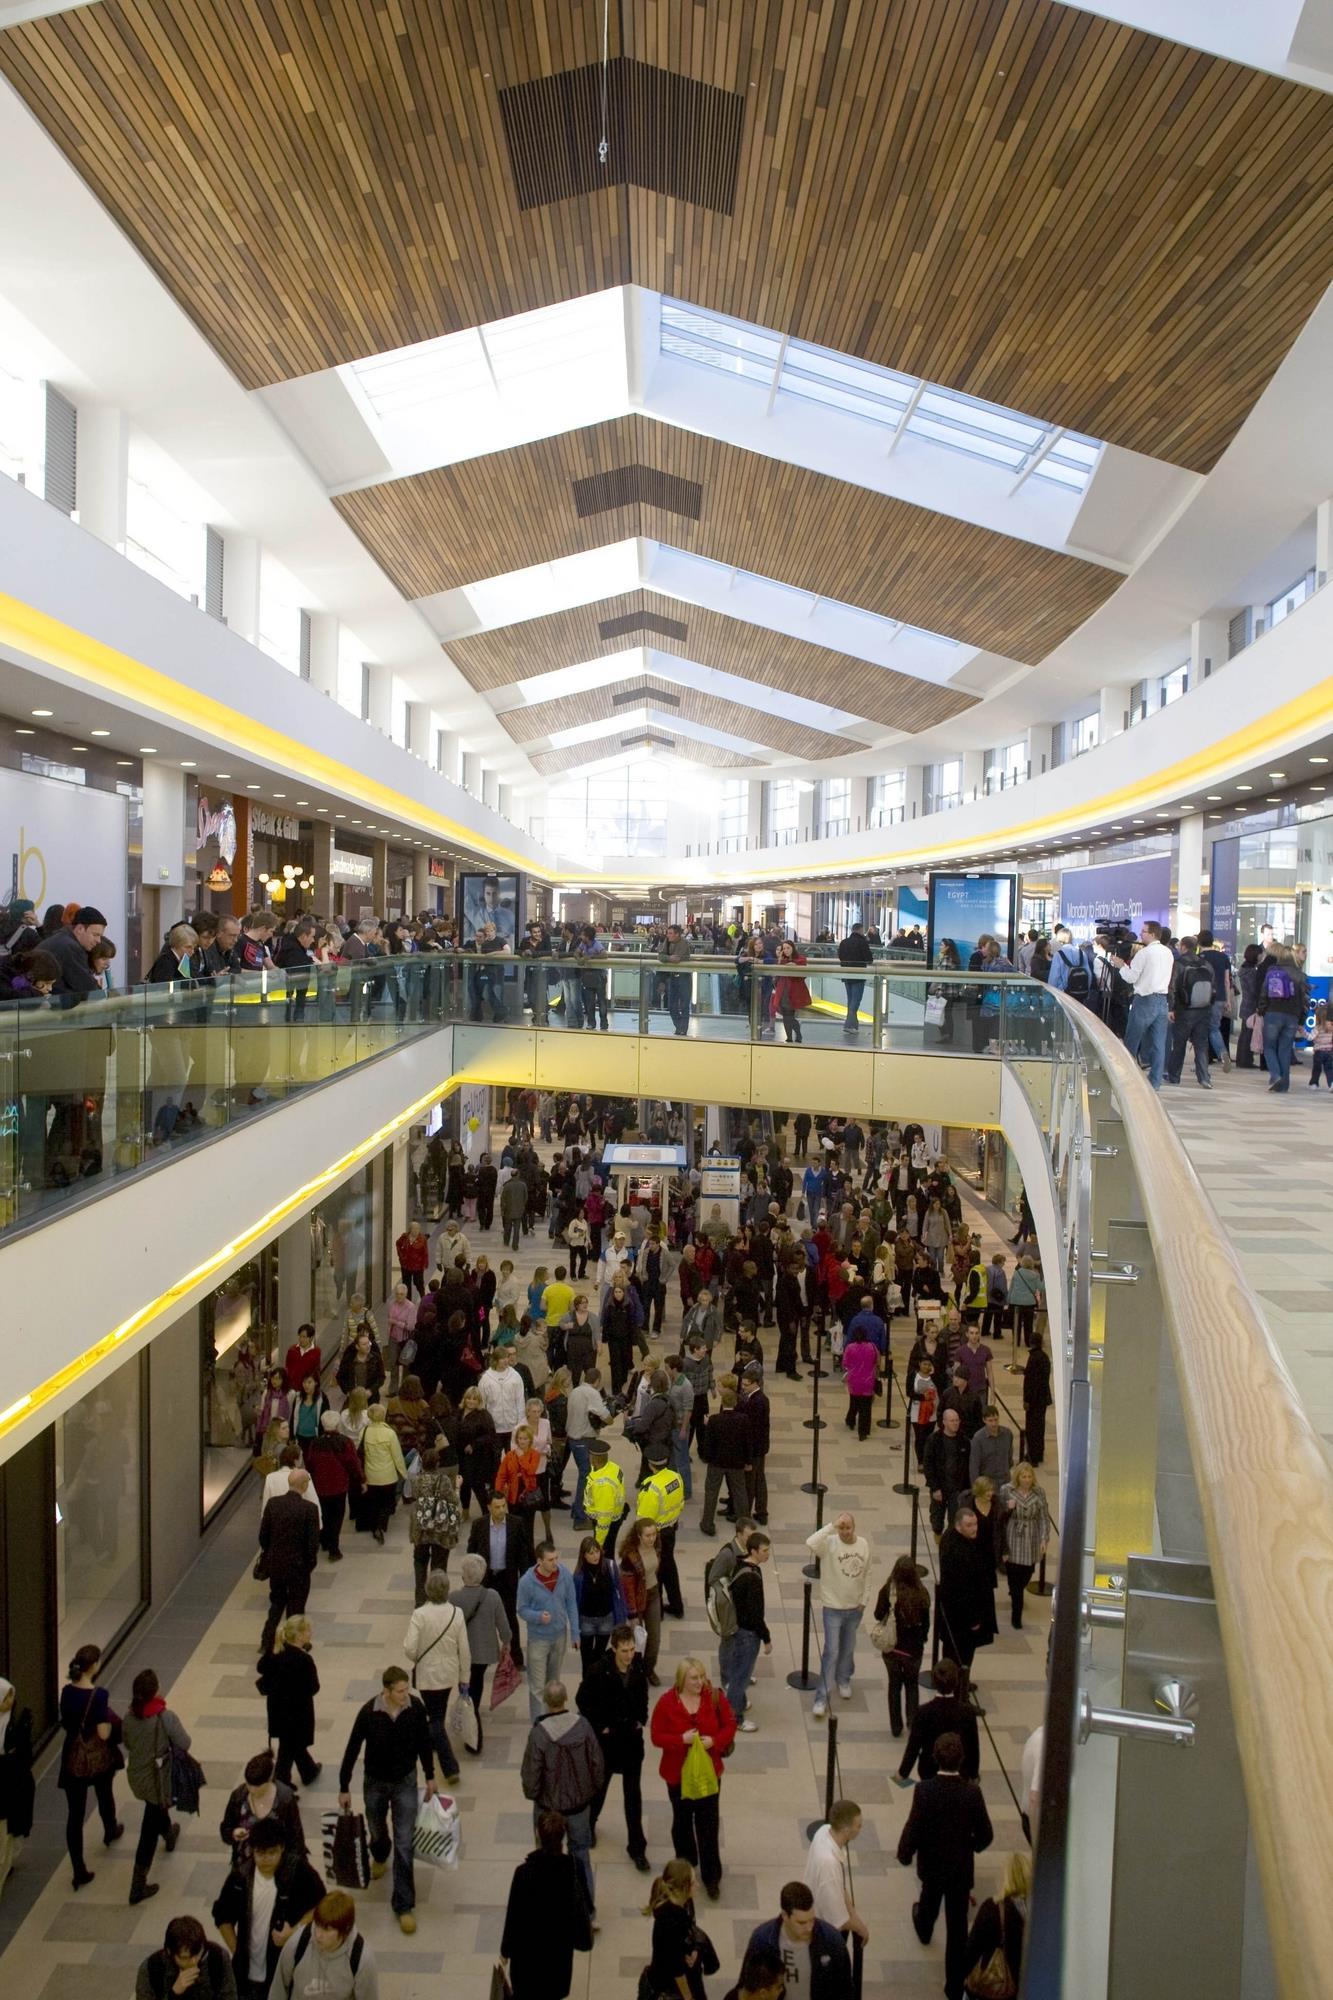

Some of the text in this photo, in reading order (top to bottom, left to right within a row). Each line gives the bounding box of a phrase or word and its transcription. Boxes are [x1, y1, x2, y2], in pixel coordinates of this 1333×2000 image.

[252, 806, 300, 840] Steak & Grill
[947, 891, 968, 899] EGYPT
[1067, 901, 1088, 920] Monday
[1088, 902, 1095, 918] to
[1095, 900, 1111, 919] Friday
